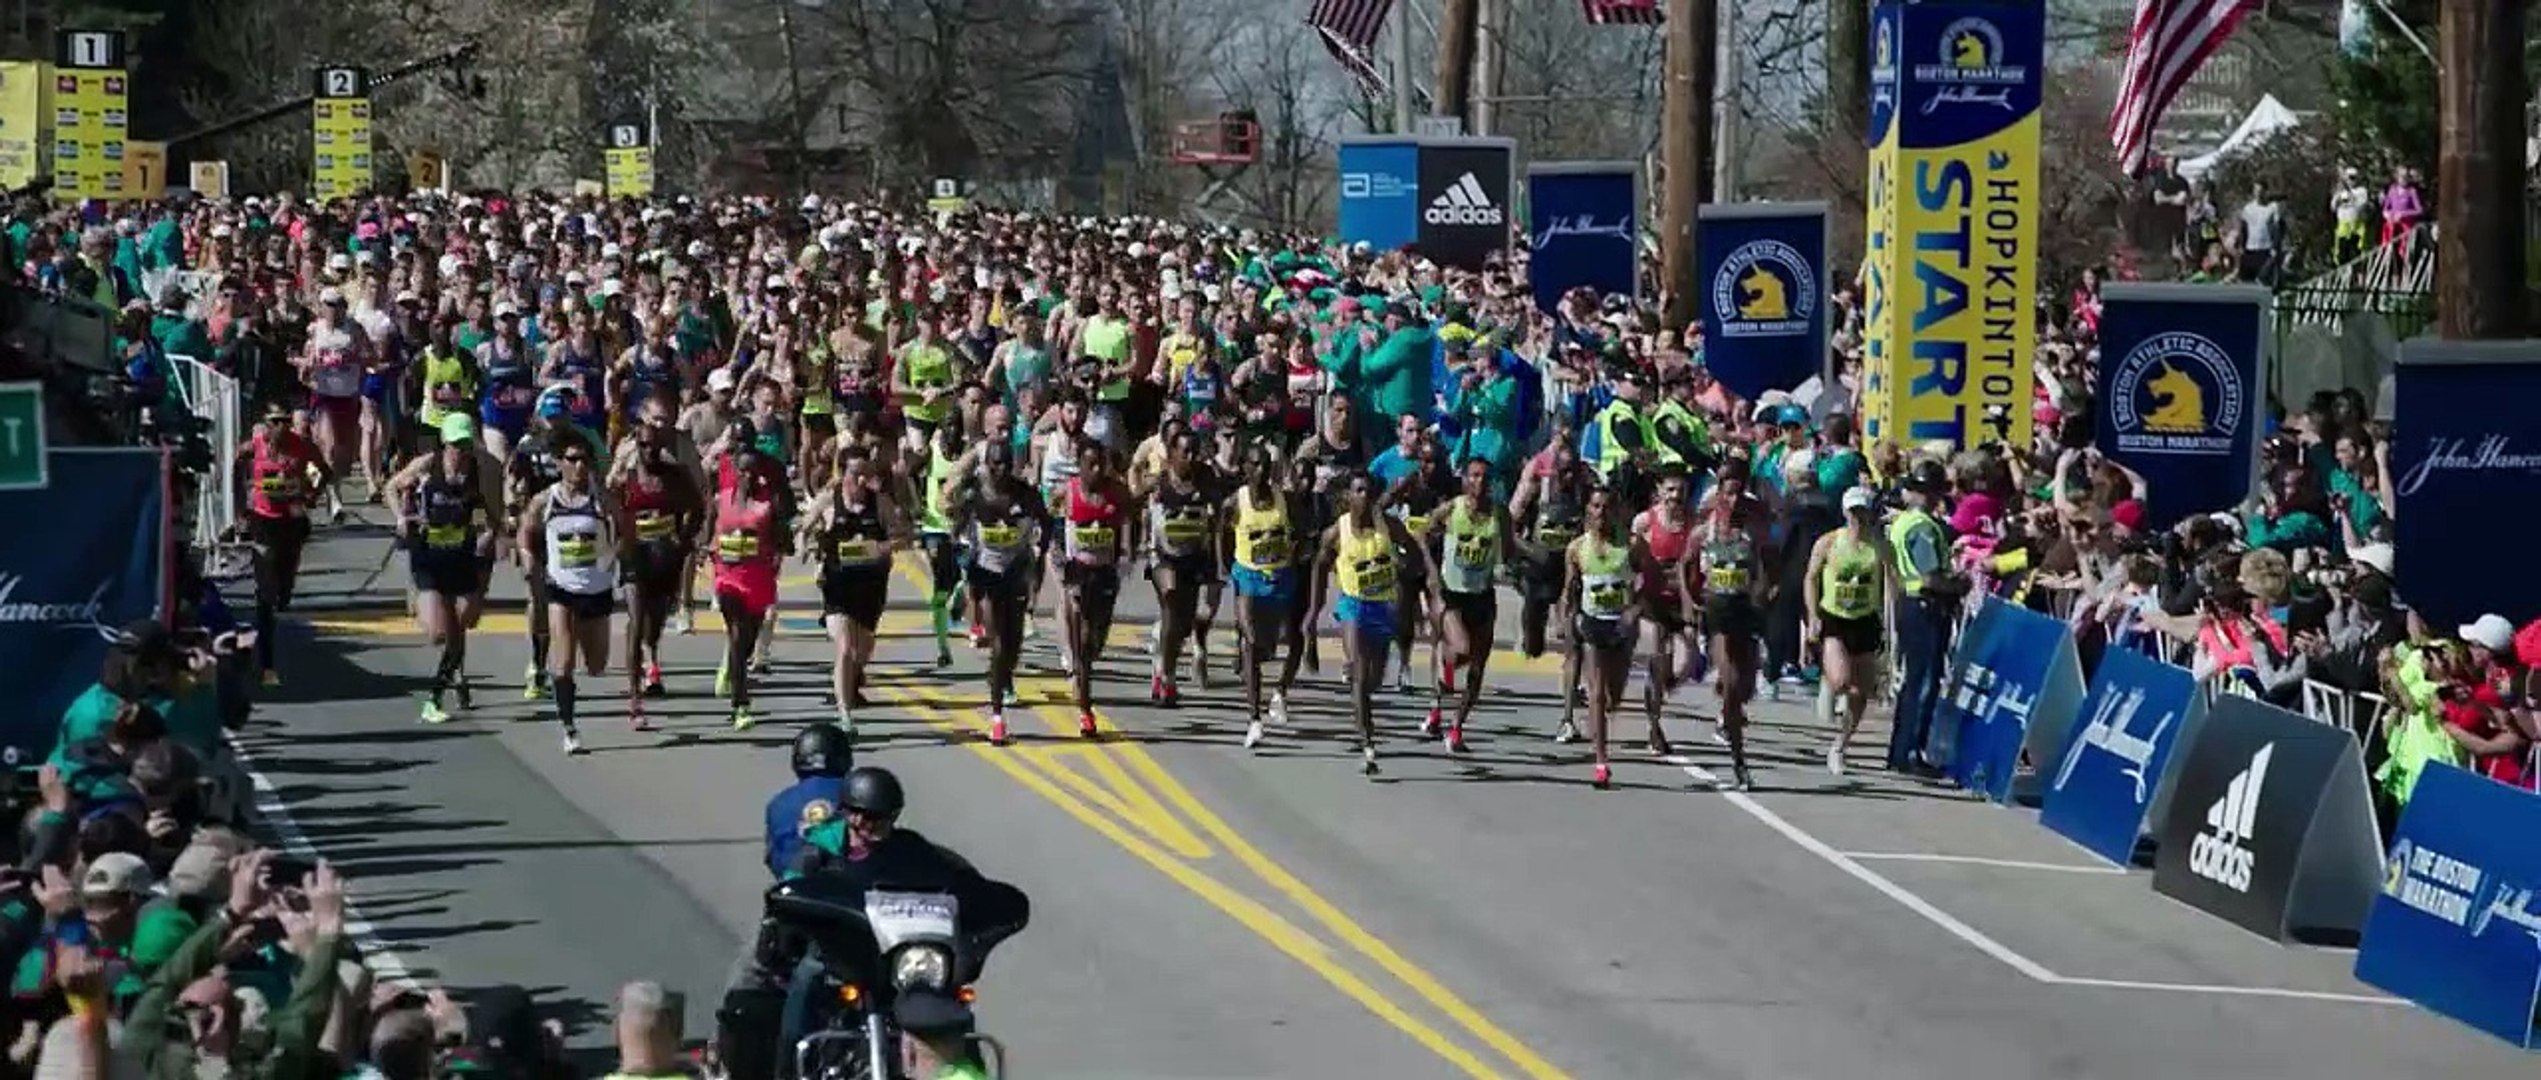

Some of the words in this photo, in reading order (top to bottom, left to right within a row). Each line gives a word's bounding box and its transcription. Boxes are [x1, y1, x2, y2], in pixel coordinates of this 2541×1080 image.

[85, 37, 95, 63] 1
[333, 72, 349, 93] 2
[138, 165, 149, 191] 1
[1424, 203, 1502, 225] adidas
[1912, 159, 1972, 451] START
[2116, 370, 2134, 423] BOSTON
[2117, 434, 2163, 447] BOSTON
[2189, 826, 2256, 893] adidas
[2432, 853, 2483, 895] BOSTON
[2401, 876, 2473, 927] MARATHON
